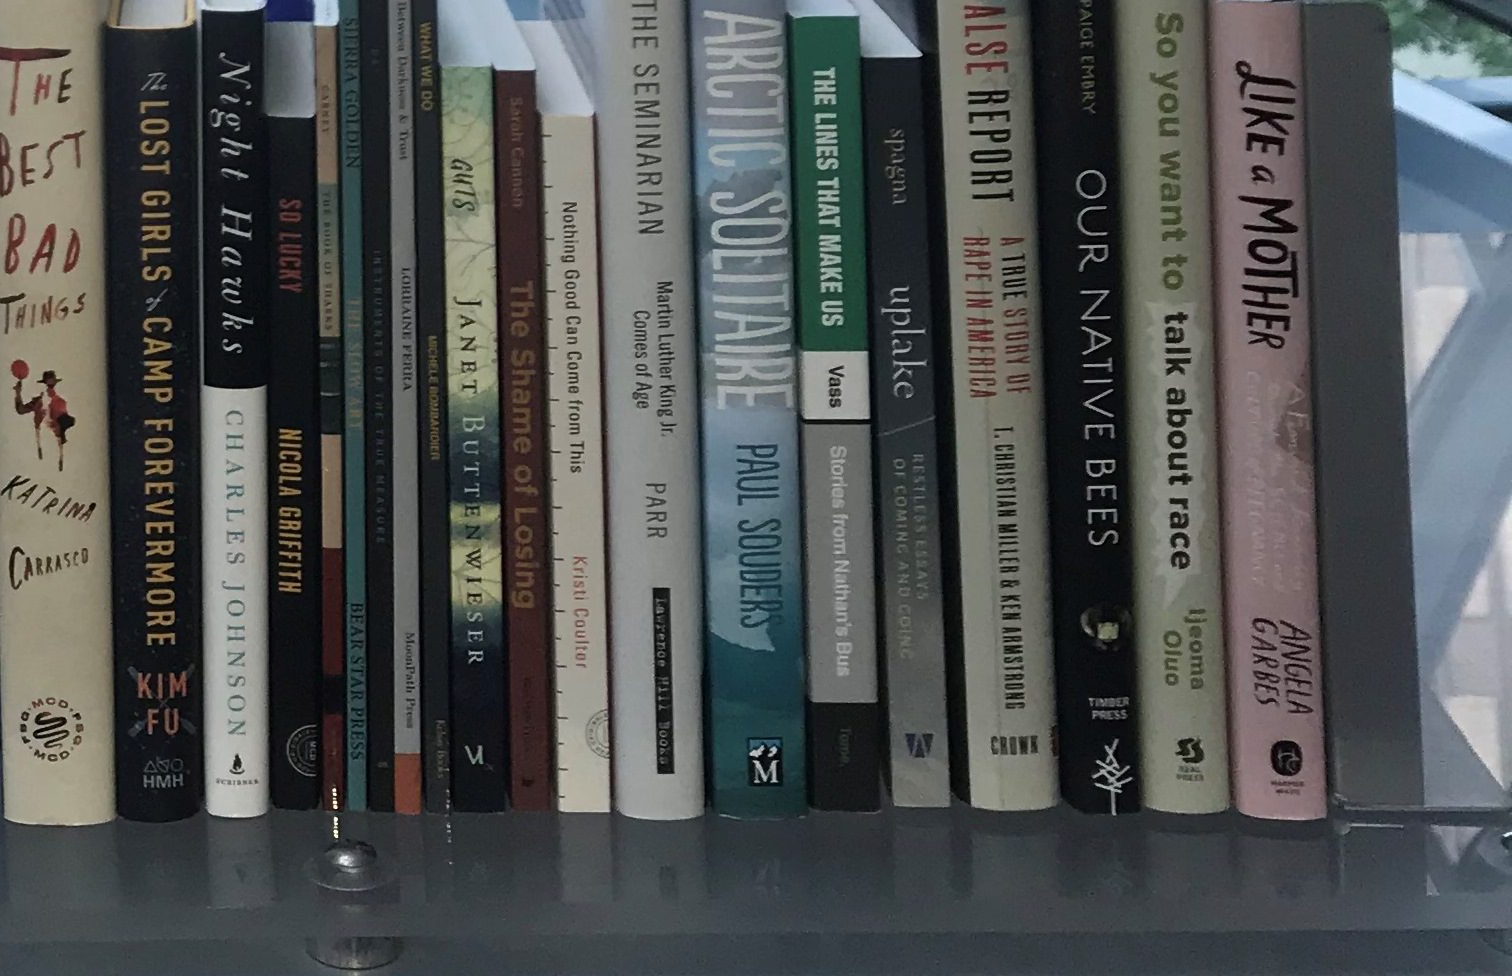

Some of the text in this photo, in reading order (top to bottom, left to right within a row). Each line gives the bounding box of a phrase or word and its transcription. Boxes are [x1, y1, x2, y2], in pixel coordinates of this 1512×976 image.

[343, 18, 362, 169] SIERRA GOLDEN
[420, 21, 433, 61] WHAT
[1080, 55, 1096, 115] EMBRY
[633, 63, 665, 236] SEMINARIAN
[967, 89, 1015, 203] REPORT
[1234, 60, 1298, 157] LIKE
[140, 100, 171, 283] LOST GIRLS
[209, 51, 254, 354] Night Hawks
[278, 198, 303, 294] SO LUCKY
[701, 9, 794, 411] ARCTIC SOLITAIRE
[812, 66, 845, 327] THE LINES THAT MAKE US
[400, 266, 413, 341] LORRAINE
[561, 201, 586, 474] Nothing Good Can Come from This
[1001, 253, 1028, 301] TRUE
[1149, 12, 1194, 571] So you want to talk about race
[1237, 195, 1300, 351] MOTHER
[828, 364, 846, 409] Vass
[879, 285, 928, 400] uplake
[967, 317, 997, 399] AMERICA
[1075, 170, 1120, 547] OUR NATIVE BEES
[143, 316, 176, 647] CAMP FOREVERMORE
[453, 296, 487, 665] JANET BUTTENWIESER
[509, 348, 540, 610] Shame Losing
[645, 482, 669, 540] PARR
[735, 444, 785, 630] PAUL SOUDERS
[894, 485, 908, 553] COMING
[911, 453, 926, 536] RESTLESS
[994, 443, 1020, 574] CHRISTIAN MILLER
[221, 410, 247, 738] CHARLES JOHNSON
[278, 507, 303, 594] GRIFFITH
[832, 513, 852, 677] from Bus
[136, 671, 187, 700] KIM
[350, 603, 366, 761] BEAR STAR PRESS
[655, 598, 669, 668] Lawrence
[146, 707, 181, 736] FU
